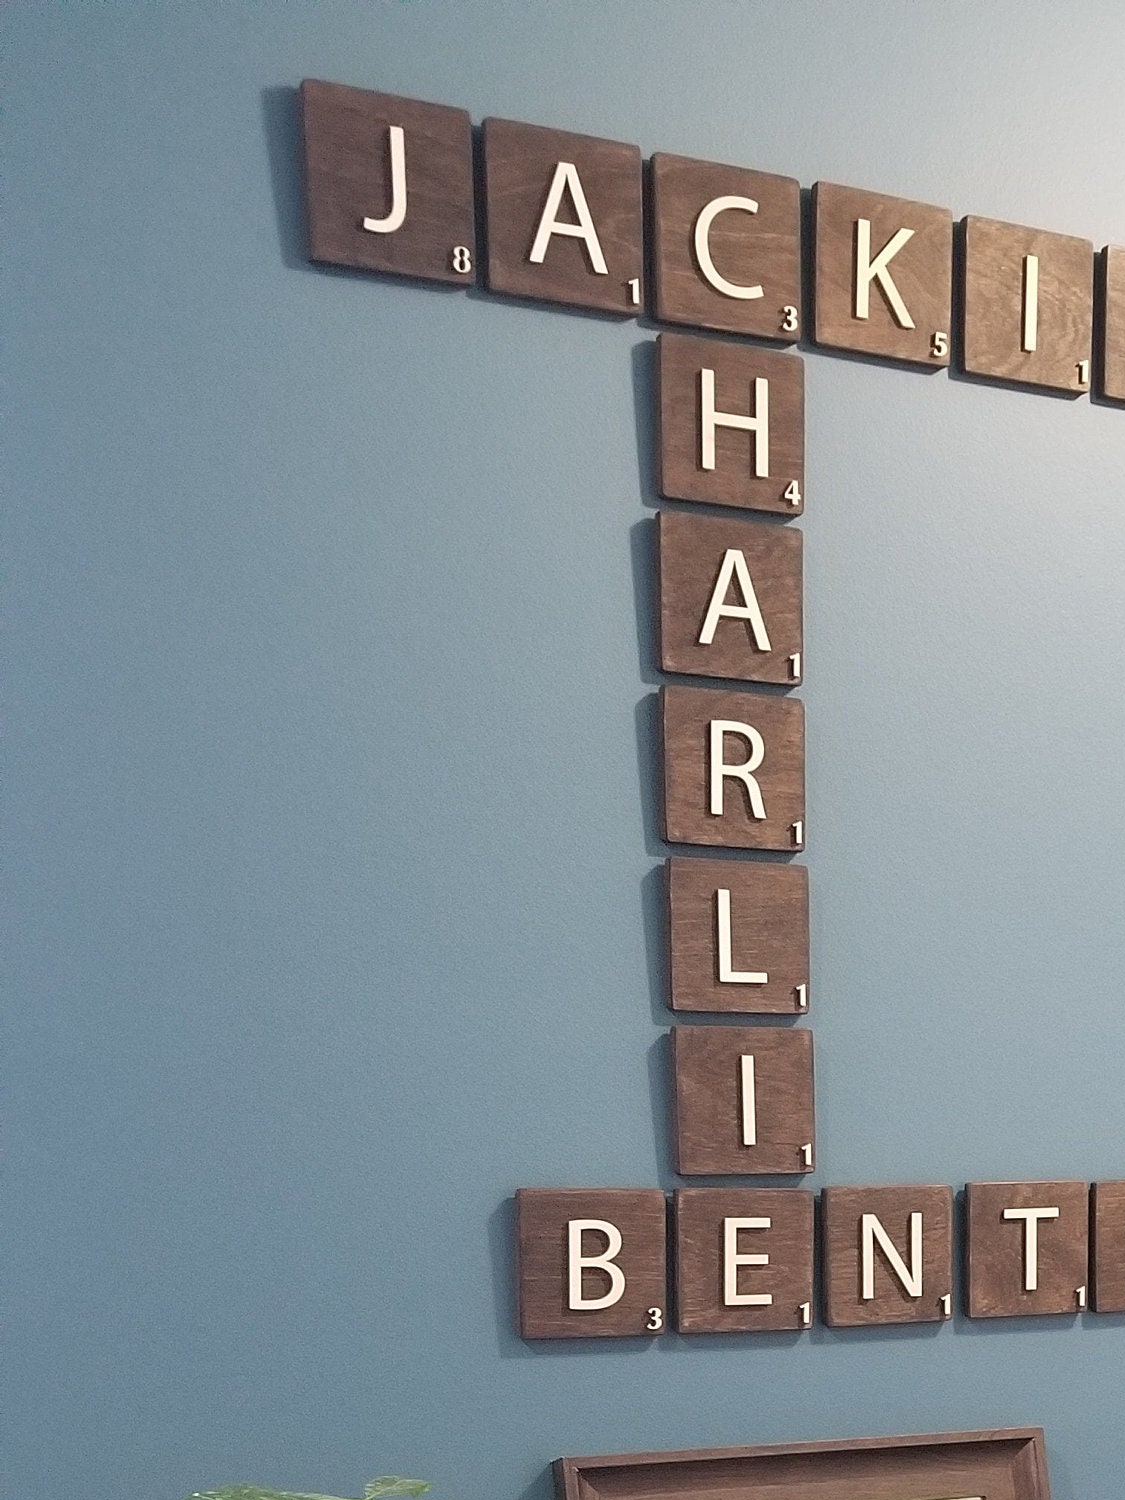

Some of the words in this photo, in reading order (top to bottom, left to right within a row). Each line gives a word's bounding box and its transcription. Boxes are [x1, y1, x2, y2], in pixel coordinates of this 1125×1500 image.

[453, 246, 471, 273] 8
[628, 278, 640, 304] 1
[782, 305, 798, 331] 3
[933, 331, 949, 357] 5
[1077, 359, 1089, 383] 1
[784, 479, 801, 506] 4
[788, 652, 801, 678] 1
[694, 195, 773, 1306] CHARLIE
[792, 820, 804, 844] 1
[795, 983, 807, 1007] 1
[801, 1143, 813, 1166] 1
[940, 1293, 952, 1315] 1
[1075, 1285, 1087, 1308] 1
[646, 1307, 663, 1330] 3
[799, 1302, 811, 1324] 1
